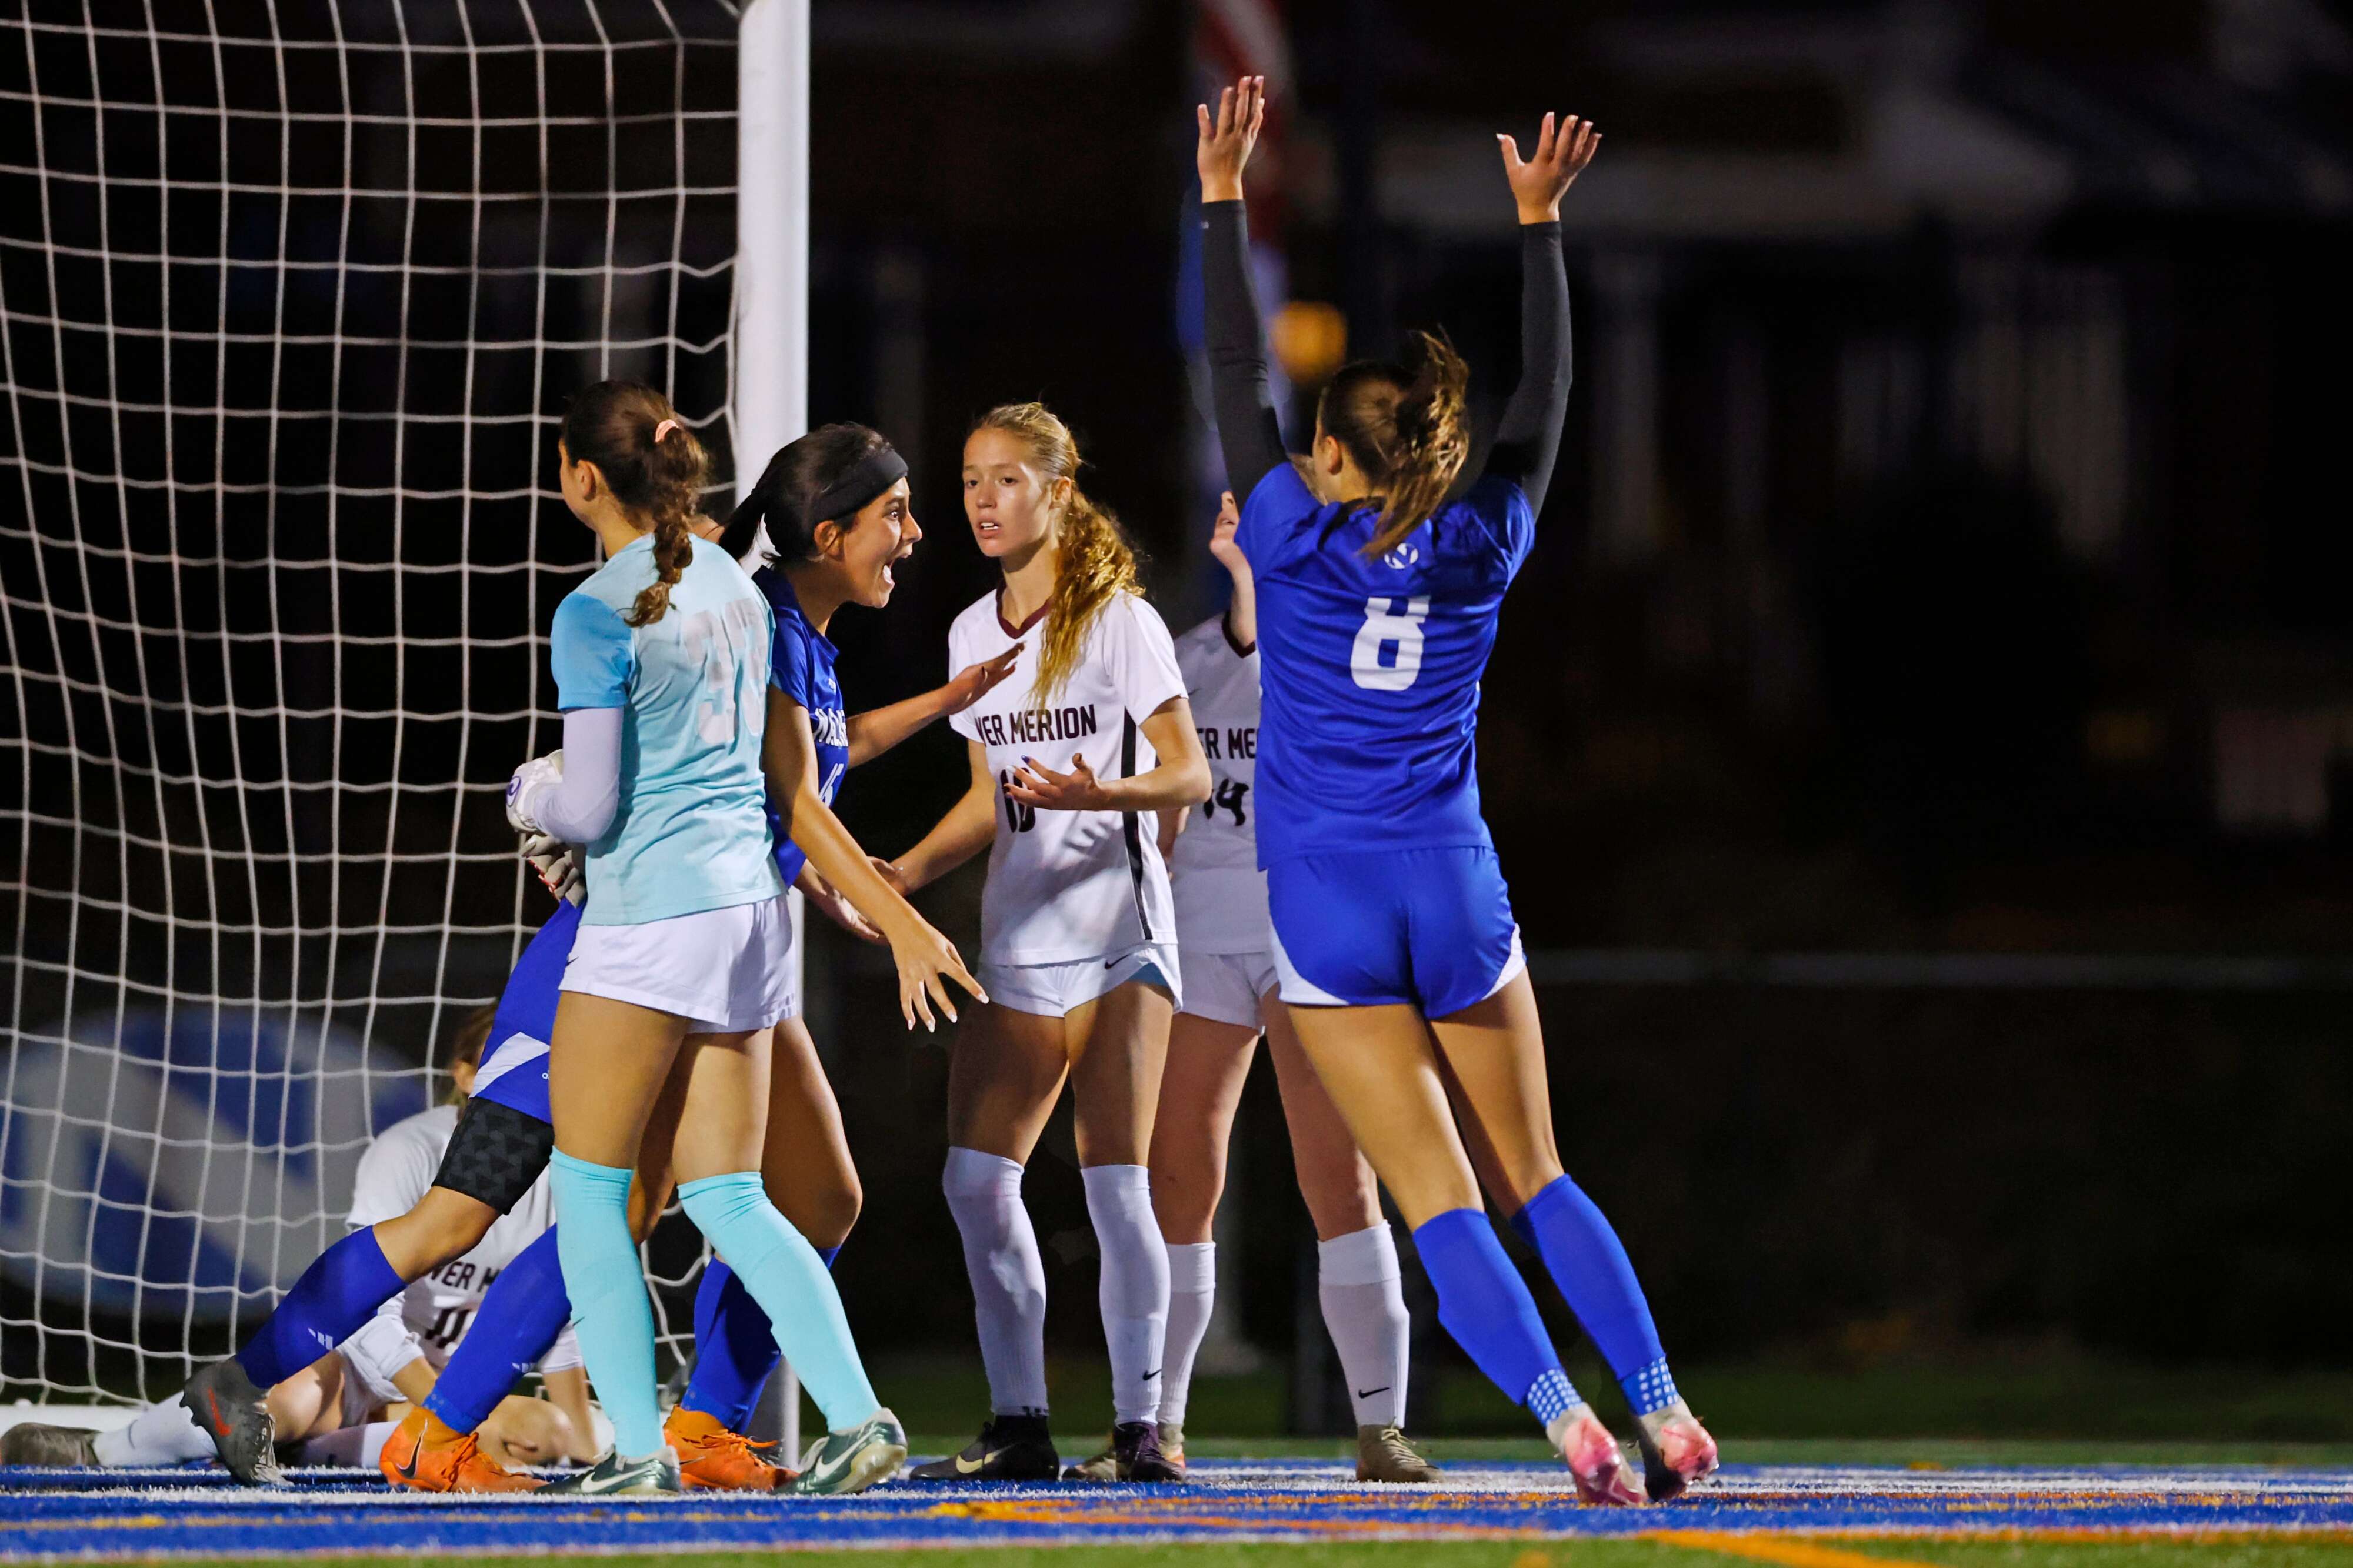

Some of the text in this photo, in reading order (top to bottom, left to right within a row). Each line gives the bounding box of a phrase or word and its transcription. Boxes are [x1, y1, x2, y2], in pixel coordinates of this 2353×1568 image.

[1350, 595, 1431, 692] 8
[1009, 704, 1096, 744] MERION
[1228, 728, 1259, 759] ME
